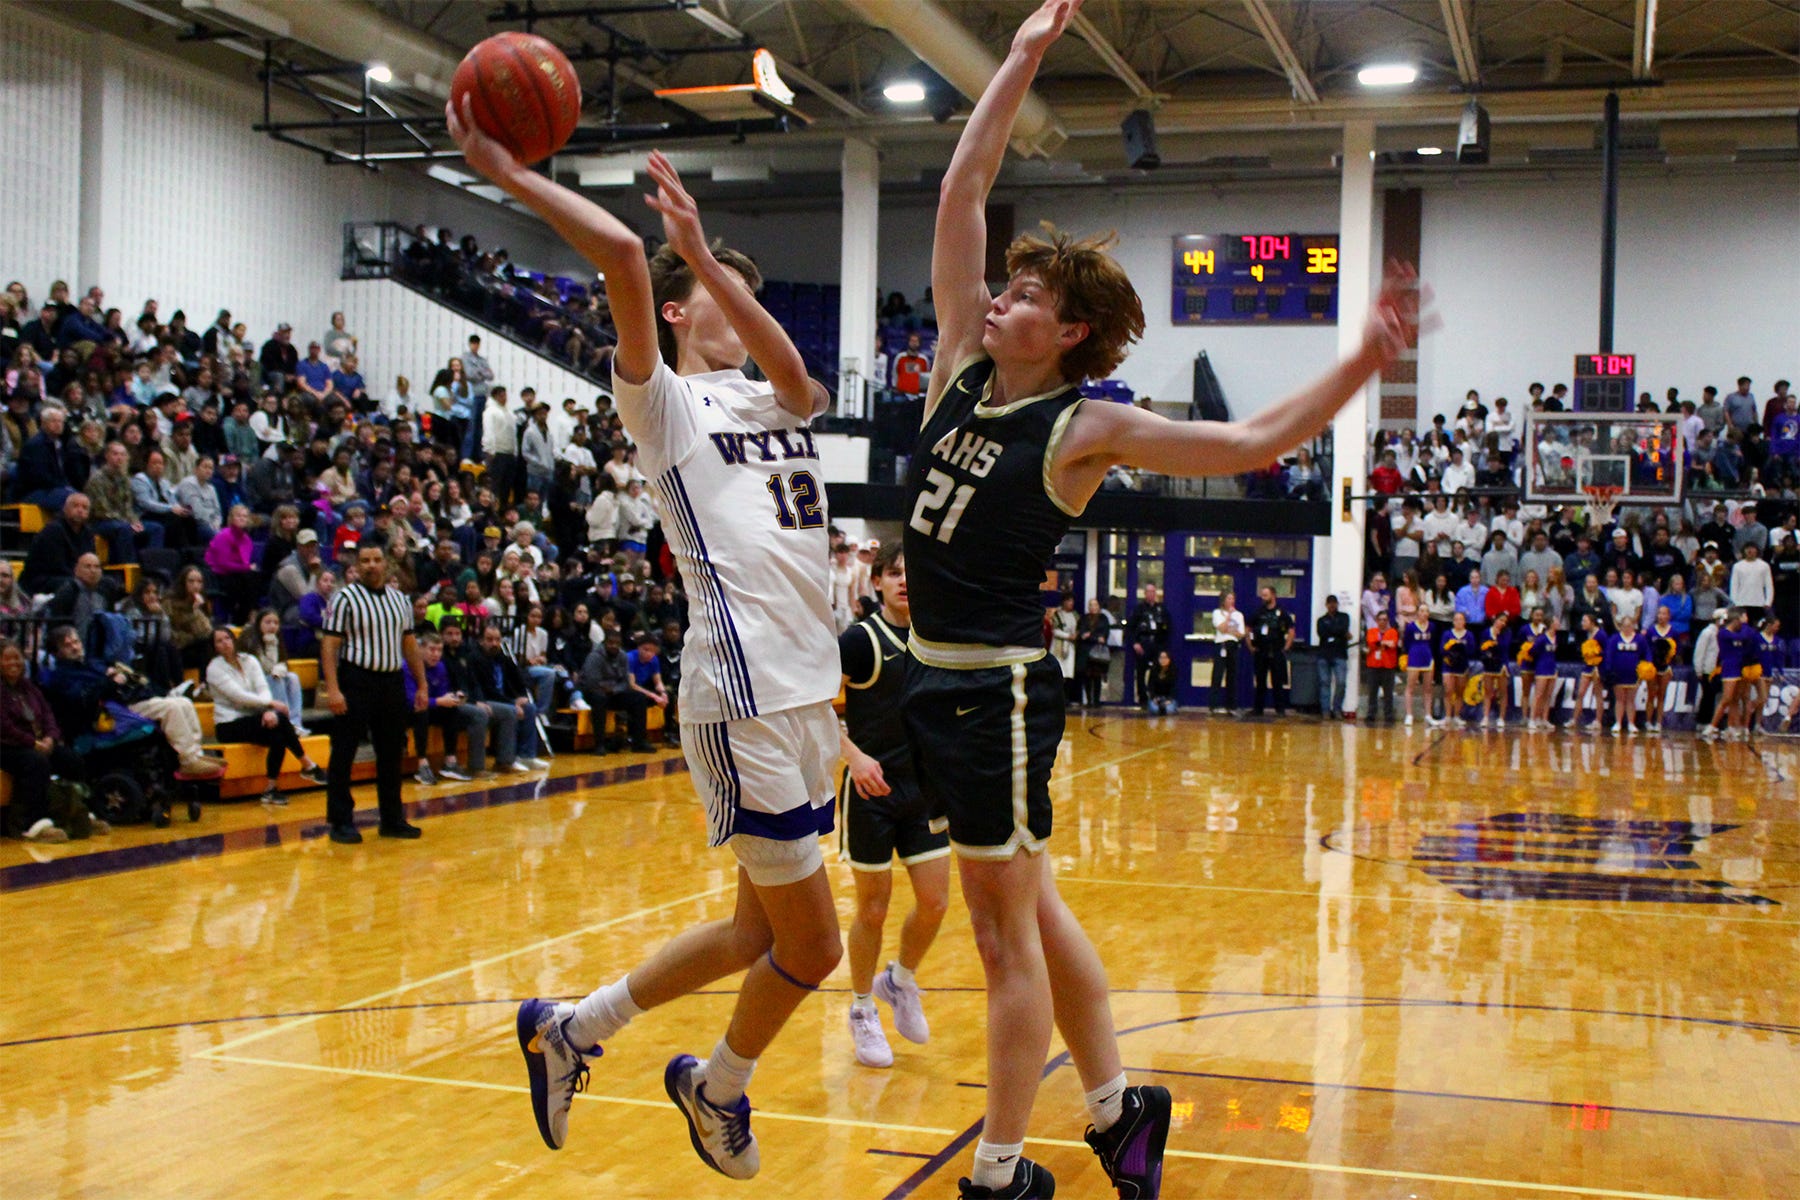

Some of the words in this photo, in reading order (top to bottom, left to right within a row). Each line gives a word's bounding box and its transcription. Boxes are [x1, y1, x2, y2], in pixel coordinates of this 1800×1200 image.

[1183, 249, 1215, 275] 44
[1250, 264, 1264, 282] 4
[1306, 247, 1337, 273] 32
[708, 427, 820, 465] WYLI
[930, 426, 1004, 478] AHS
[766, 471, 824, 529] 12
[909, 467, 976, 544] 21
